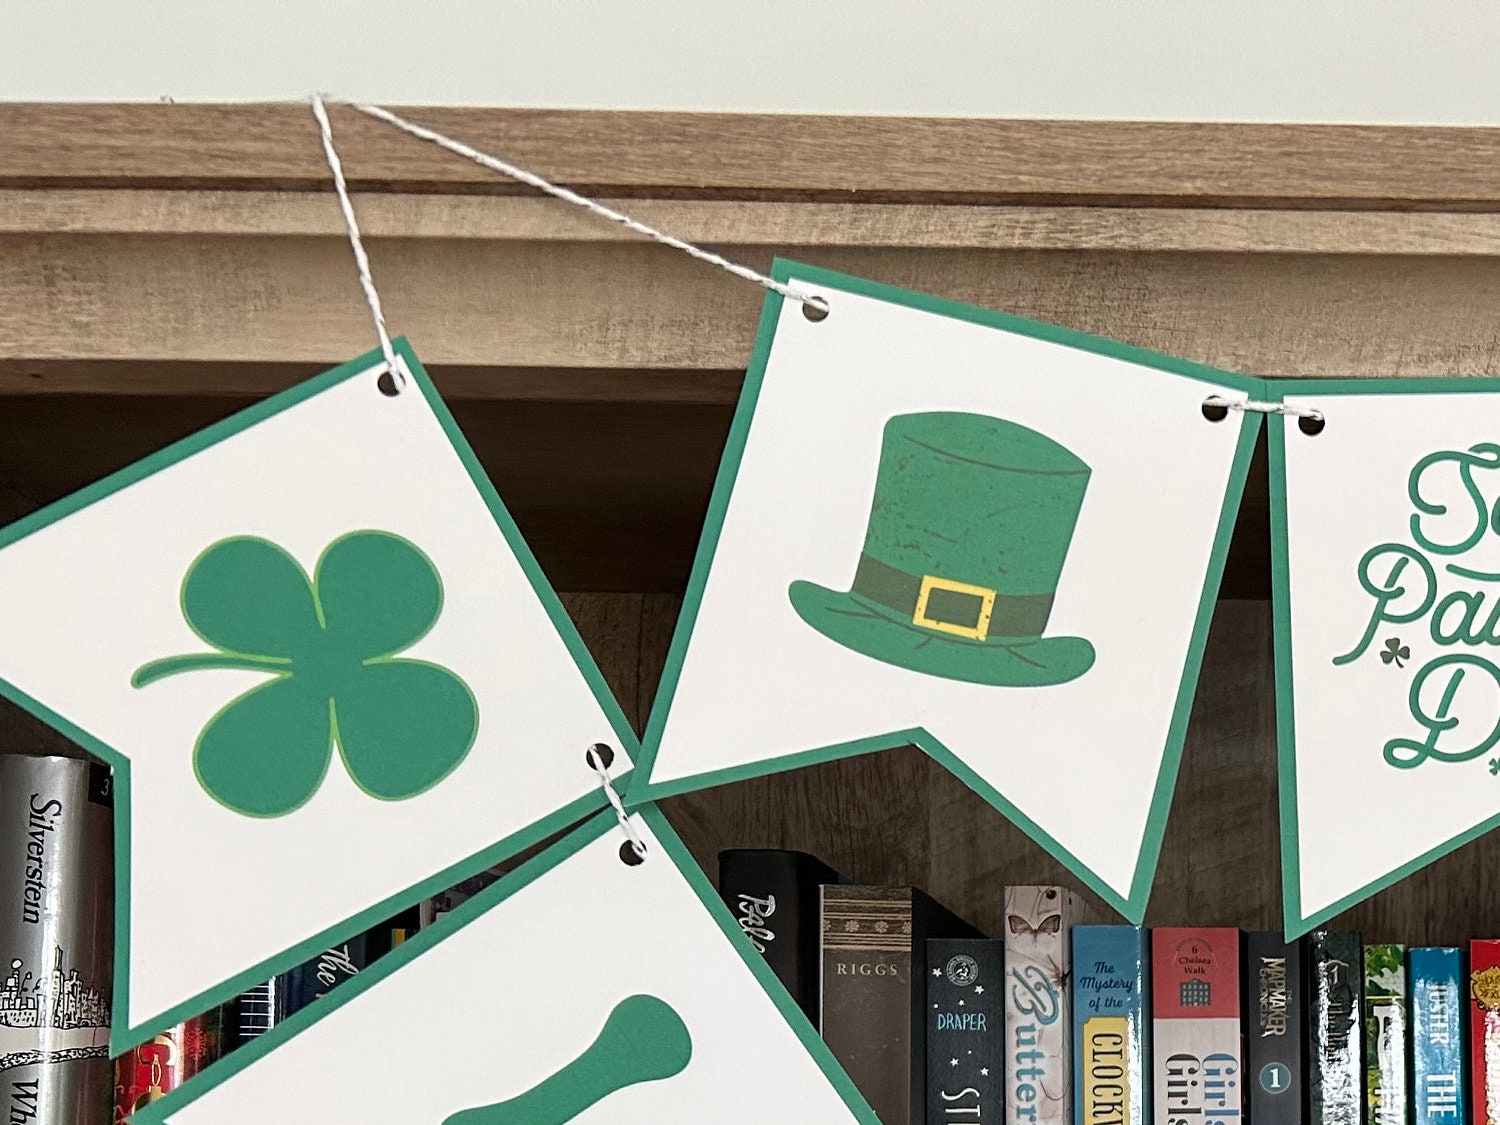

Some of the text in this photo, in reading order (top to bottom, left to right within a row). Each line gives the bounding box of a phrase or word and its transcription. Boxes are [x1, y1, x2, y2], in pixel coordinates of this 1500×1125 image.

[22, 792, 62, 925] Silverstein
[1094, 961, 1116, 973] The
[1179, 956, 1211, 965] Chelsea
[837, 963, 898, 976] RIGGS
[1184, 966, 1206, 974] Walk
[1080, 976, 1133, 993] Mystery
[1088, 996, 1123, 1012] of the
[1260, 957, 1287, 1038] MAPMAKER
[938, 1013, 987, 1031] DRAPER
[1428, 985, 1449, 1045] JUSTER
[1270, 1068, 1281, 1088] 1
[1426, 1070, 1457, 1118] THE
